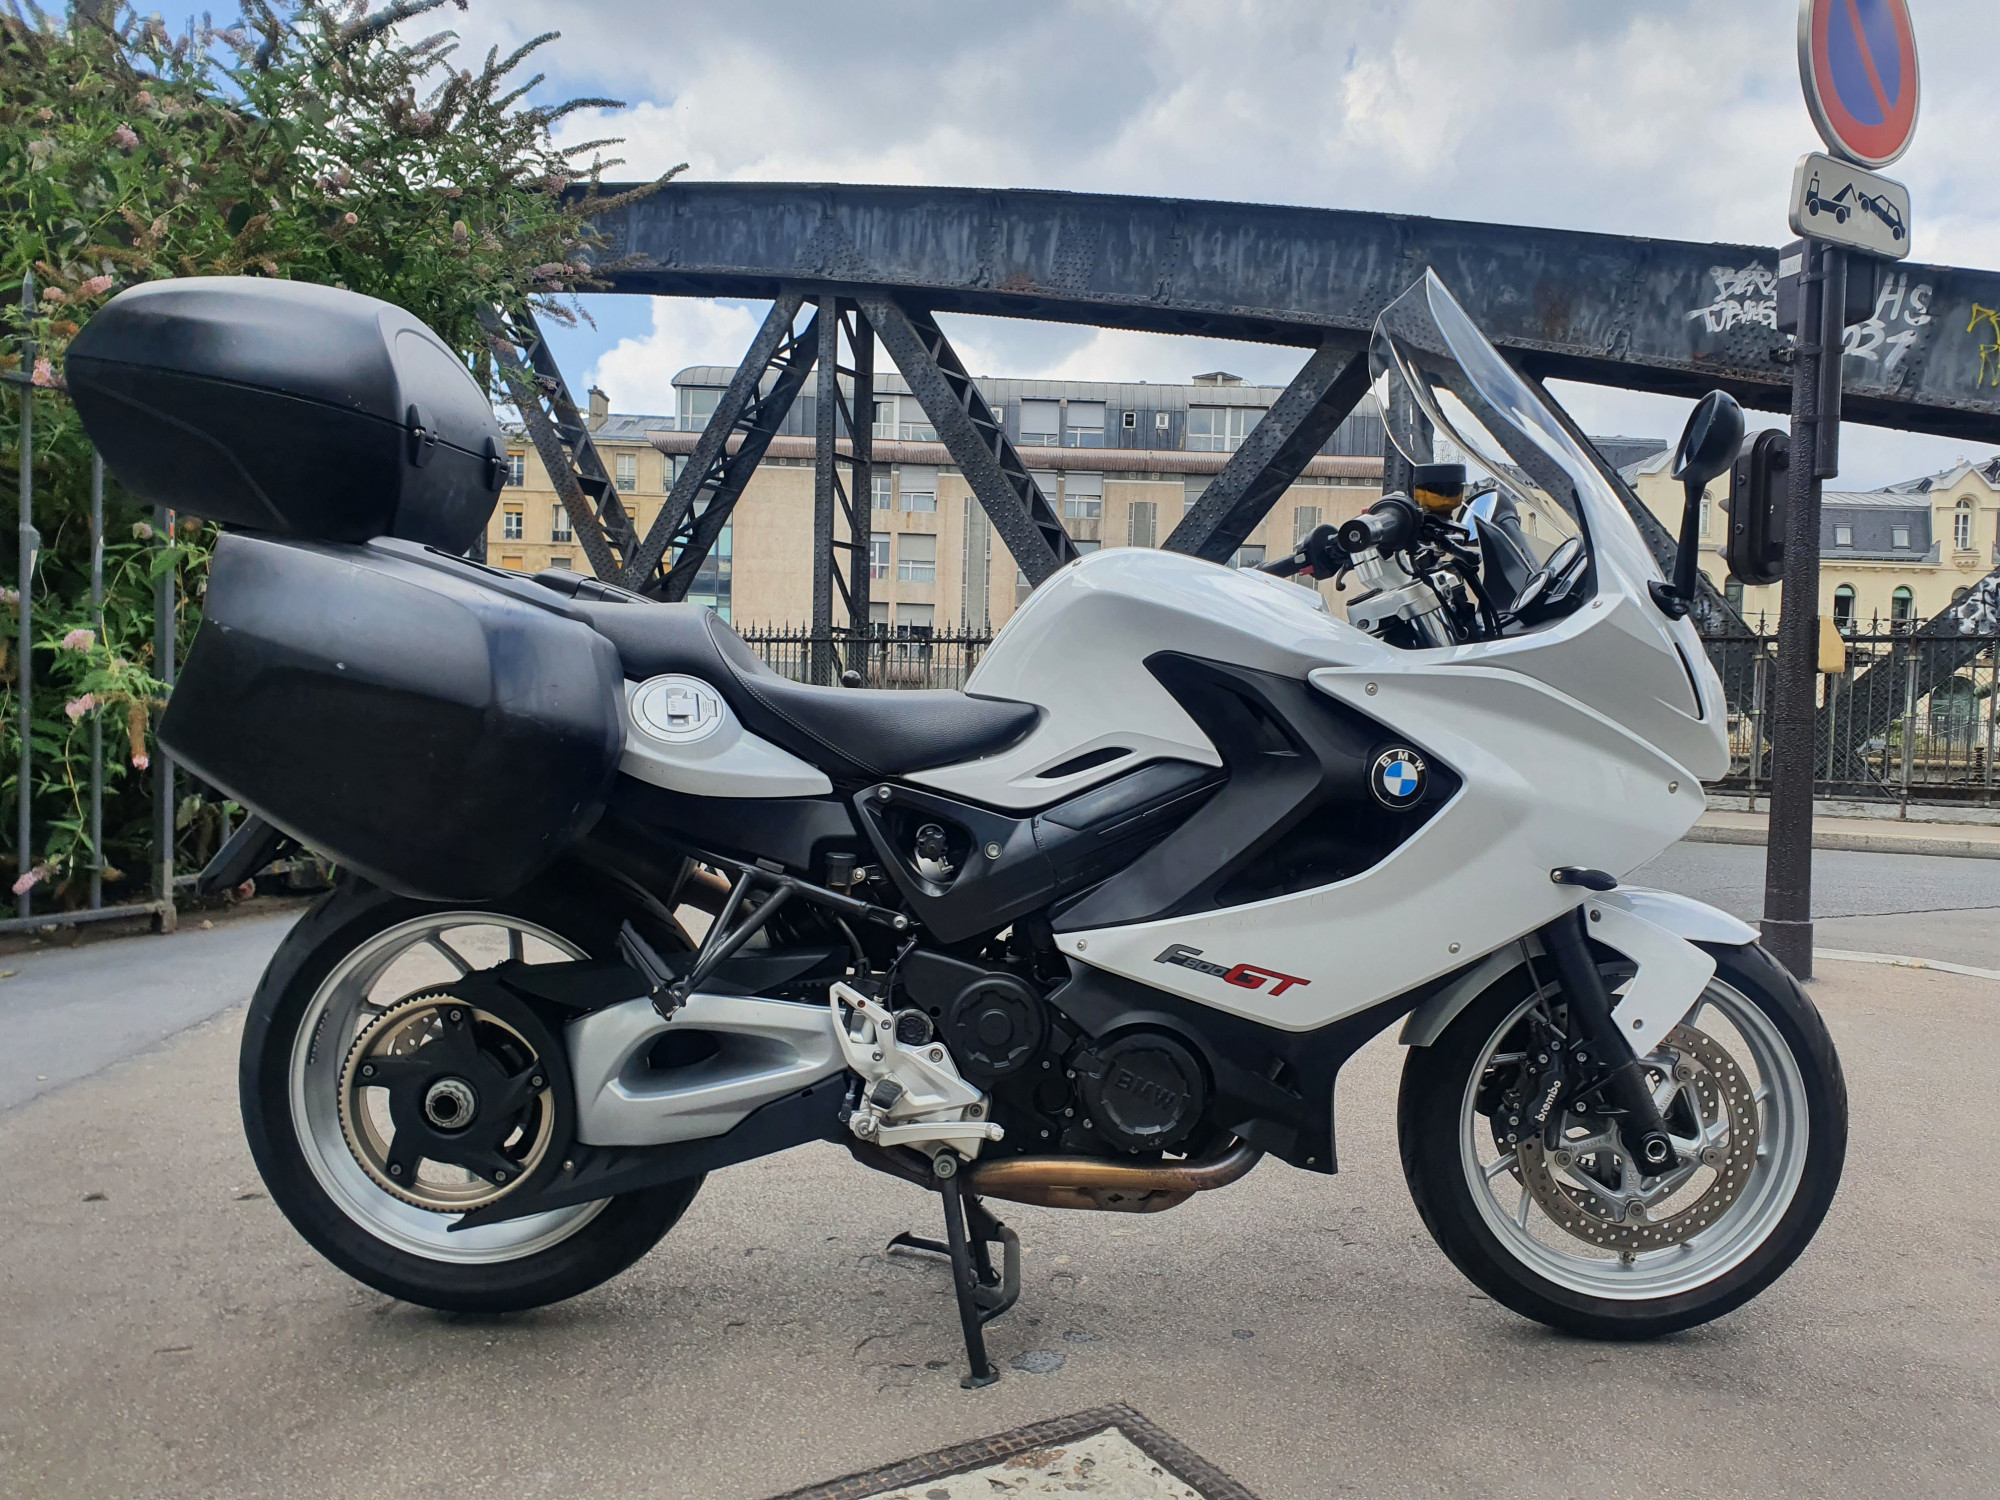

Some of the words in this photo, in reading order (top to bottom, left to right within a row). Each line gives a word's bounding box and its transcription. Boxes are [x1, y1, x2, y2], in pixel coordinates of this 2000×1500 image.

[1380, 751, 1425, 772] BMW
[1115, 1068, 1177, 1110] BMW
[1534, 1080, 1562, 1122] brembo
